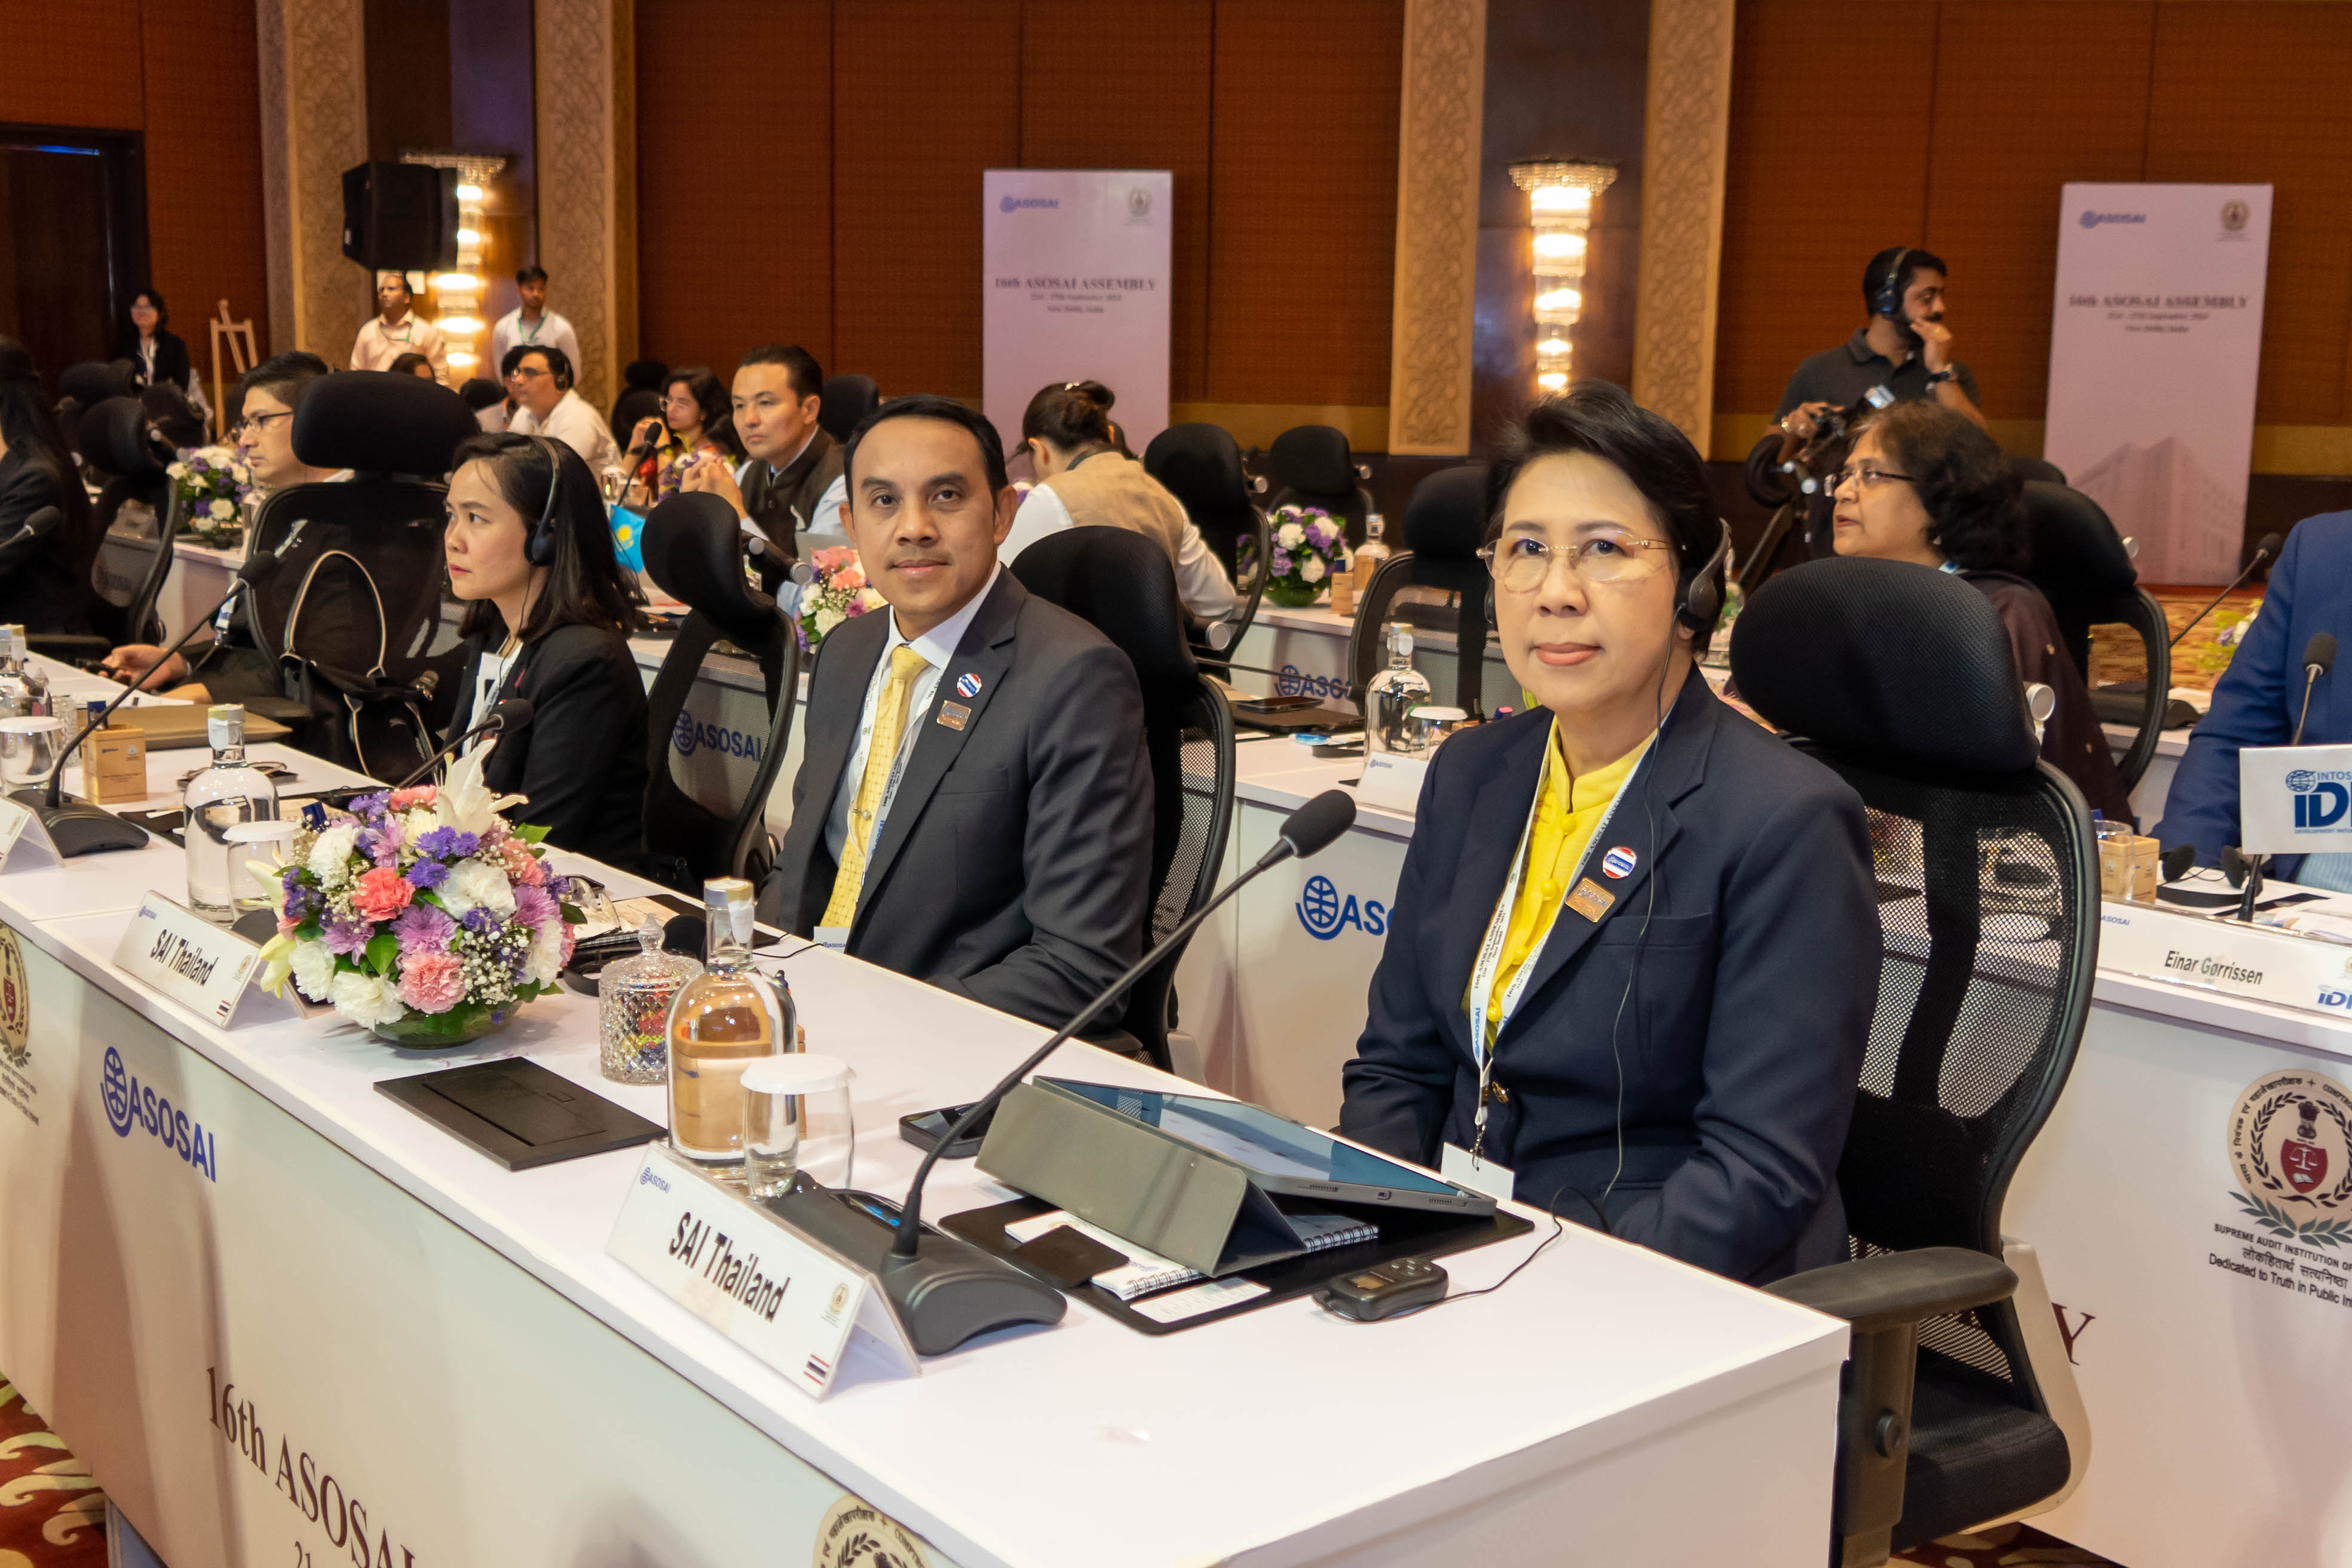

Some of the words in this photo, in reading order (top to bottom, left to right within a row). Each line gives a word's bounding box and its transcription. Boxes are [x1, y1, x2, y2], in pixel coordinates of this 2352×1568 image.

[995, 277, 1019, 289] 16th
[1025, 277, 1076, 289] ASOSAI
[1082, 278, 1155, 291] ASSEMBLY
[696, 721, 761, 762] ASOSAI
[2101, 915, 2130, 926] ASOSAI
[150, 929, 178, 963] SAI
[168, 938, 219, 987] Thailand
[1473, 973, 1481, 988] 16th
[1477, 944, 1491, 972] ASOSAI
[1487, 903, 1505, 942] ASSEMBLY
[2164, 950, 2199, 972] Einar
[130, 1076, 216, 1183] ASOSAI
[648, 1173, 670, 1194] ASOSAI
[669, 1212, 710, 1269] SAI
[703, 1232, 791, 1323] Thailand
[2215, 1223, 2254, 1243] SUPREME
[2256, 1236, 2282, 1251] AUDIT
[2284, 1244, 2339, 1268] INSTITUTION
[2209, 1253, 2256, 1278] Dedicated
[2259, 1269, 2268, 1282] to
[2271, 1271, 2295, 1291] Truth
[2309, 1284, 2339, 1305] Public
[207, 1367, 267, 1476] 16th
